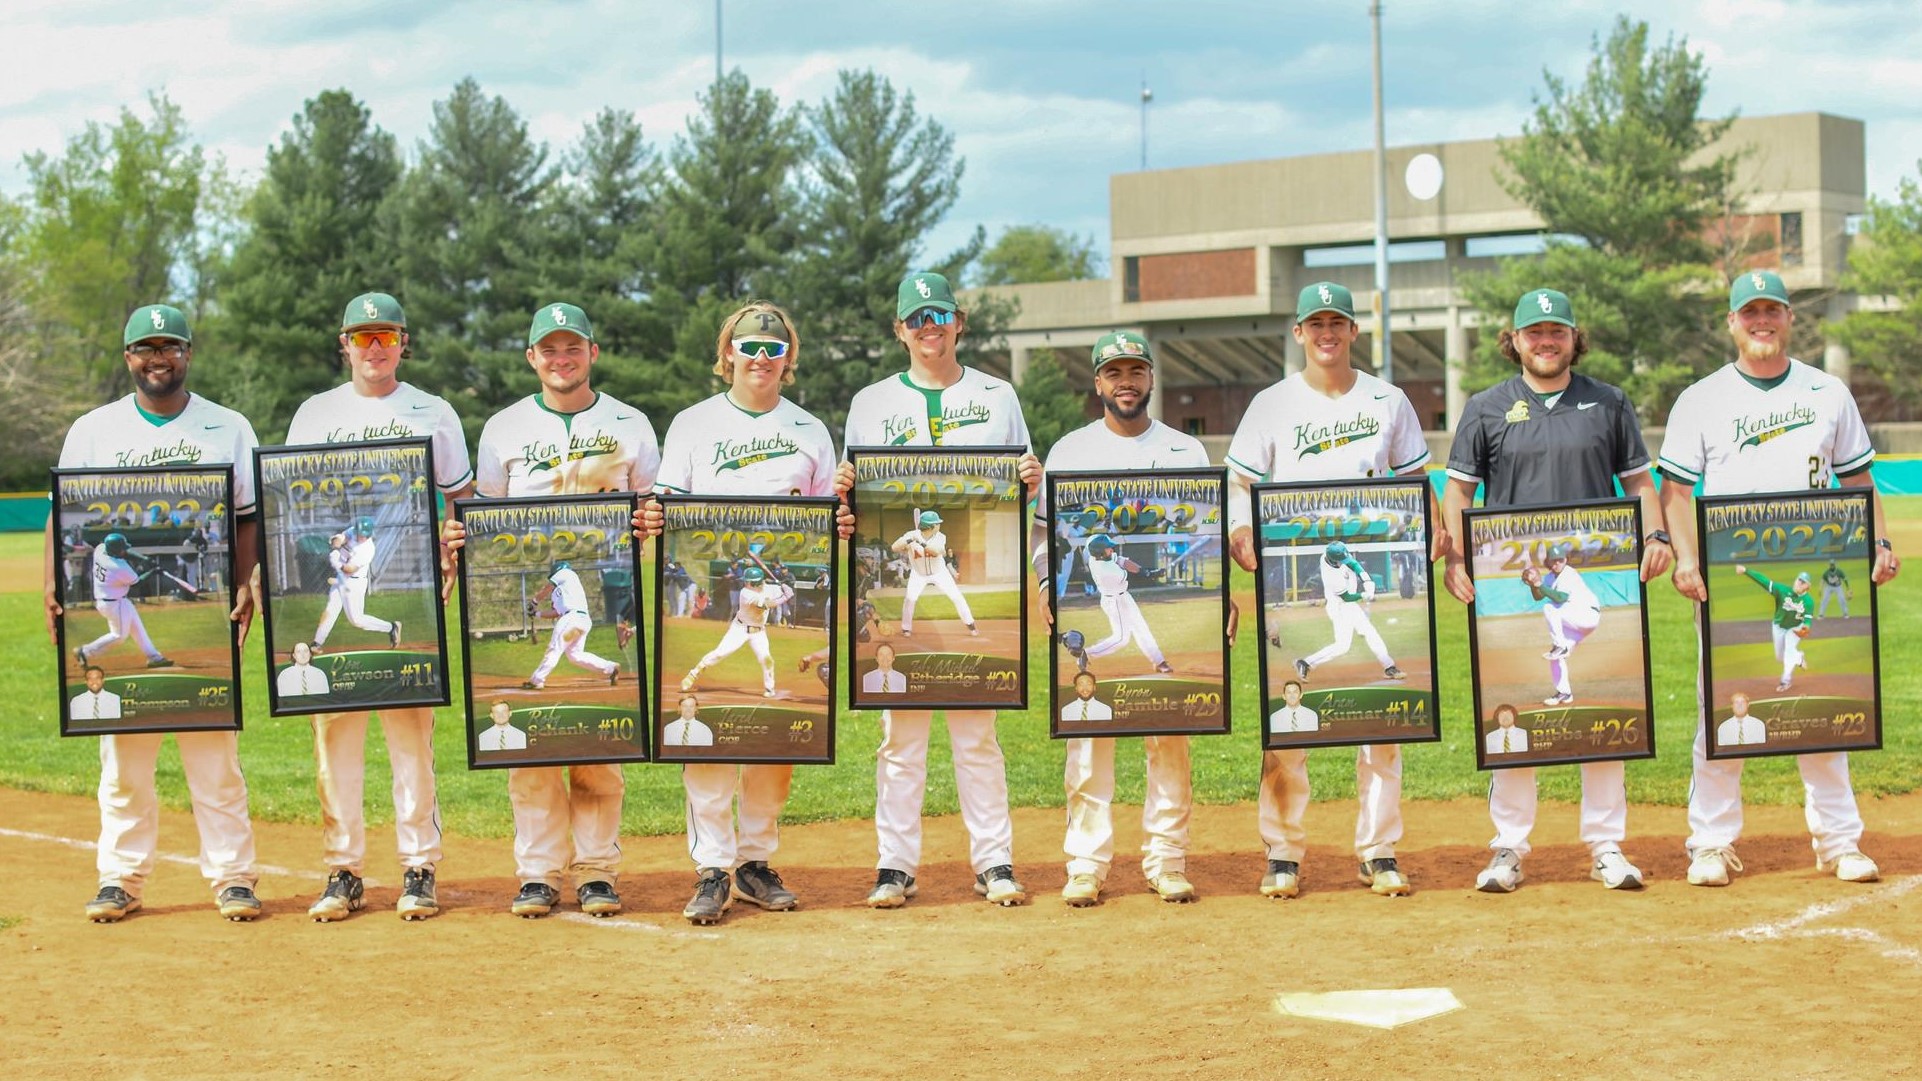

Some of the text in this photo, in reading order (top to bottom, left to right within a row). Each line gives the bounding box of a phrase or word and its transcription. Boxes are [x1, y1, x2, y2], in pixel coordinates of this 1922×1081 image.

[1293, 412, 1380, 450] Kentucky
[1733, 402, 1816, 443] Kentucky
[711, 432, 799, 465] Kentucky
[738, 454, 768, 468] State
[262, 448, 426, 484] KENTUCKY STATE UNIVERSITY
[857, 456, 1021, 482] KENTUCKY STATE UNIVERSITY
[60, 472, 227, 504] KENTUCKY STATE UNIVERSITY
[290, 473, 403, 509] 2022
[882, 480, 997, 509] 2022
[1056, 479, 1222, 506] KENTUCKY STATE UNIVERSITY
[666, 504, 833, 531] KENTUCKY STATE UNIVERSITY
[1261, 488, 1423, 519] KENTUCKY STATE UNIVERSITY
[1706, 499, 1867, 532] KENTUCKY STATE UNIVERSITY
[465, 504, 631, 536] KENTUCKY STATE UNIVERSITY
[1082, 503, 1197, 534] 2022
[1288, 513, 1399, 543] 2022
[1472, 509, 1635, 546] KENTUCKY STATE UNIVERSITY
[492, 529, 608, 562] 2022
[691, 530, 807, 560] 2022
[1732, 523, 1844, 559] 2022
[331, 669, 395, 682] Lawson
[400, 662, 435, 687] #11
[910, 672, 981, 687] Etheridge
[985, 671, 1018, 692] #20
[121, 699, 190, 711] Thompson
[198, 686, 230, 707] #35
[1183, 692, 1220, 717] #29
[1320, 708, 1383, 723] Kumar
[1385, 698, 1428, 727] #14
[1830, 712, 1866, 737] #23
[528, 722, 589, 736] Schank
[597, 717, 634, 742] #10
[717, 722, 769, 734] Pierce
[789, 720, 814, 743] #3
[1532, 728, 1583, 742] Bibbs
[1590, 717, 1639, 747] #26
